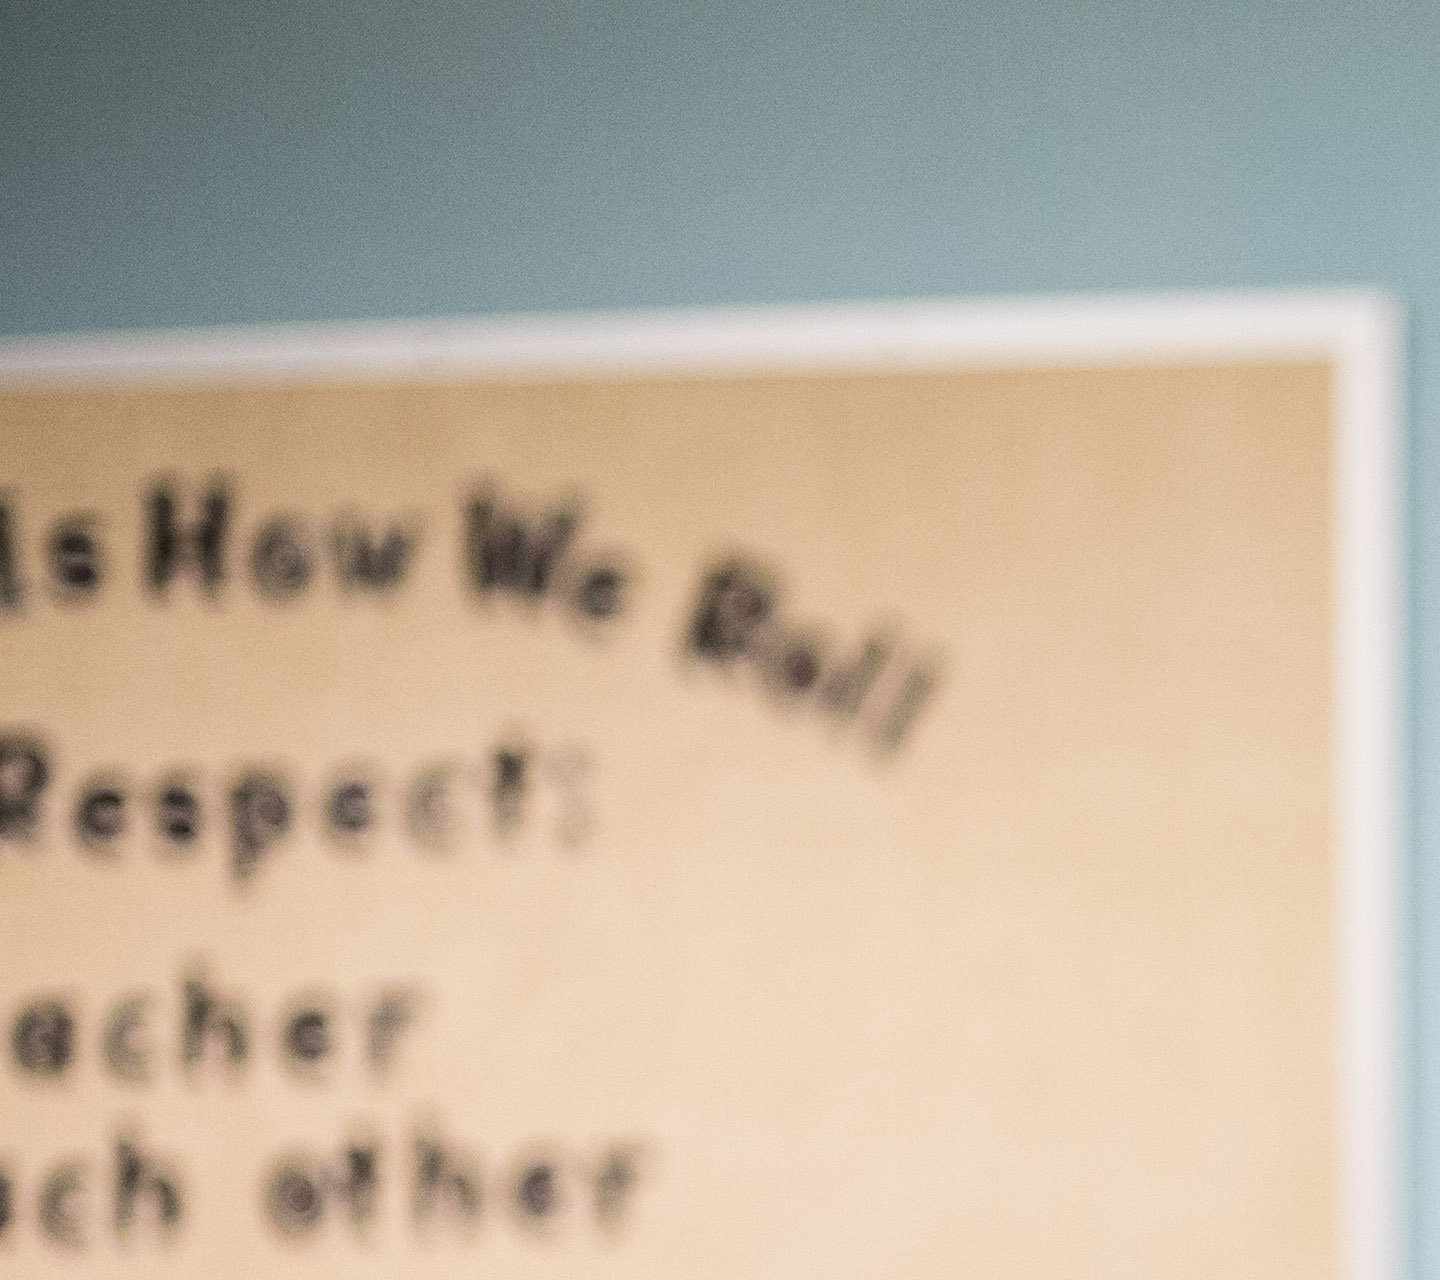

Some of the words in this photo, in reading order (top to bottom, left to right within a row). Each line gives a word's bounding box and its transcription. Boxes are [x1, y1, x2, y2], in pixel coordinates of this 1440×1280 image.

[140, 470, 422, 605] How
[460, 478, 638, 636] We
[676, 548, 940, 760] Roll
[258, 1118, 645, 1245] other
